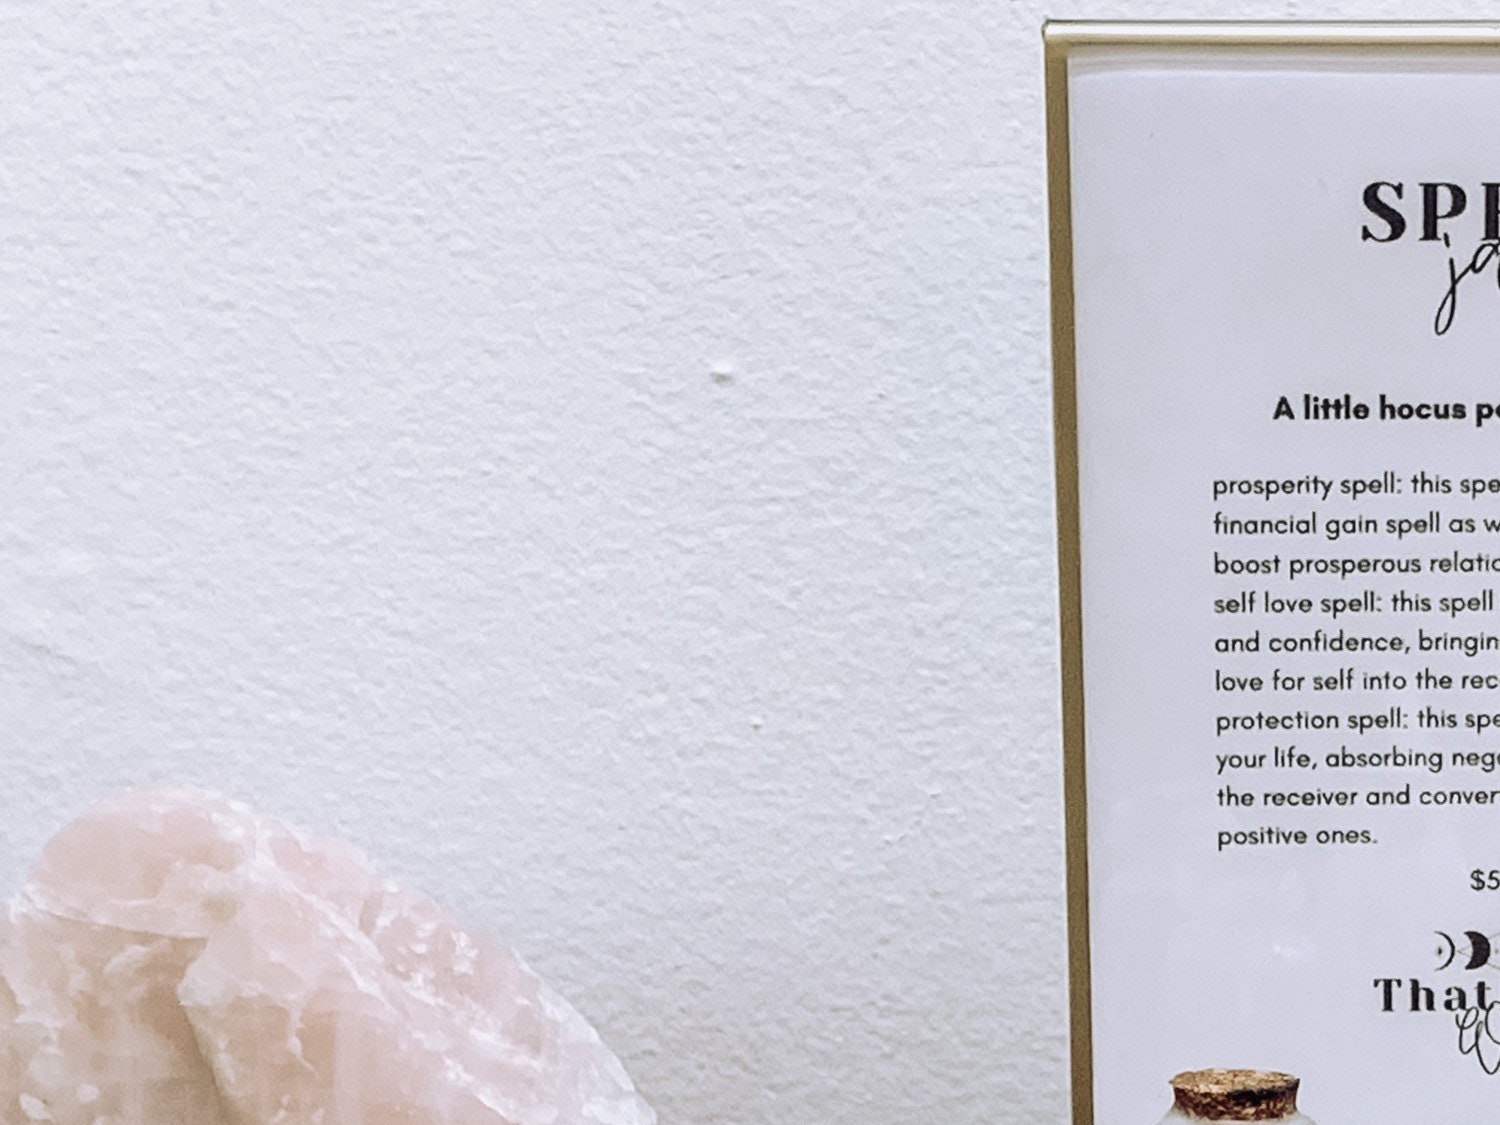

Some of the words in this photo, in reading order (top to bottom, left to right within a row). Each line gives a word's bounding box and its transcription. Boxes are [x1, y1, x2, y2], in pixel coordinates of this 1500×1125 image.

[1272, 396, 1295, 420] A
[1303, 393, 1370, 420] little
[1379, 394, 1467, 421] hocus
[1213, 475, 1333, 501] prosperity
[1340, 471, 1402, 500] spell:
[1411, 471, 1452, 494] this
[1213, 511, 1316, 535] financial
[1325, 515, 1378, 540] gain
[1386, 511, 1440, 540] spell
[1448, 518, 1476, 533] as
[1214, 552, 1281, 574] boost
[1290, 558, 1421, 580] prosperous
[1214, 590, 1256, 614] self
[1265, 591, 1313, 613] love
[1320, 590, 1382, 619] spell:
[1391, 590, 1432, 612] this
[1439, 589, 1493, 618] spell
[1215, 630, 1259, 653] and
[1269, 629, 1411, 654] confidence,
[1216, 669, 1263, 691] love
[1272, 668, 1305, 691] for
[1313, 668, 1354, 691] self
[1363, 671, 1407, 690] into
[1415, 667, 1452, 689] the
[1217, 711, 1339, 737] protection
[1347, 706, 1408, 735] spell:
[1417, 706, 1457, 728] this
[1216, 754, 1266, 775] your
[1274, 745, 1317, 770] life,
[1325, 745, 1443, 774] absorbing
[1217, 785, 1255, 807] the
[1264, 789, 1358, 806] receiver
[1366, 783, 1410, 805] and
[1218, 827, 1308, 852] positive
[1316, 830, 1378, 844] ones.
[1470, 868, 1500, 891] $5
